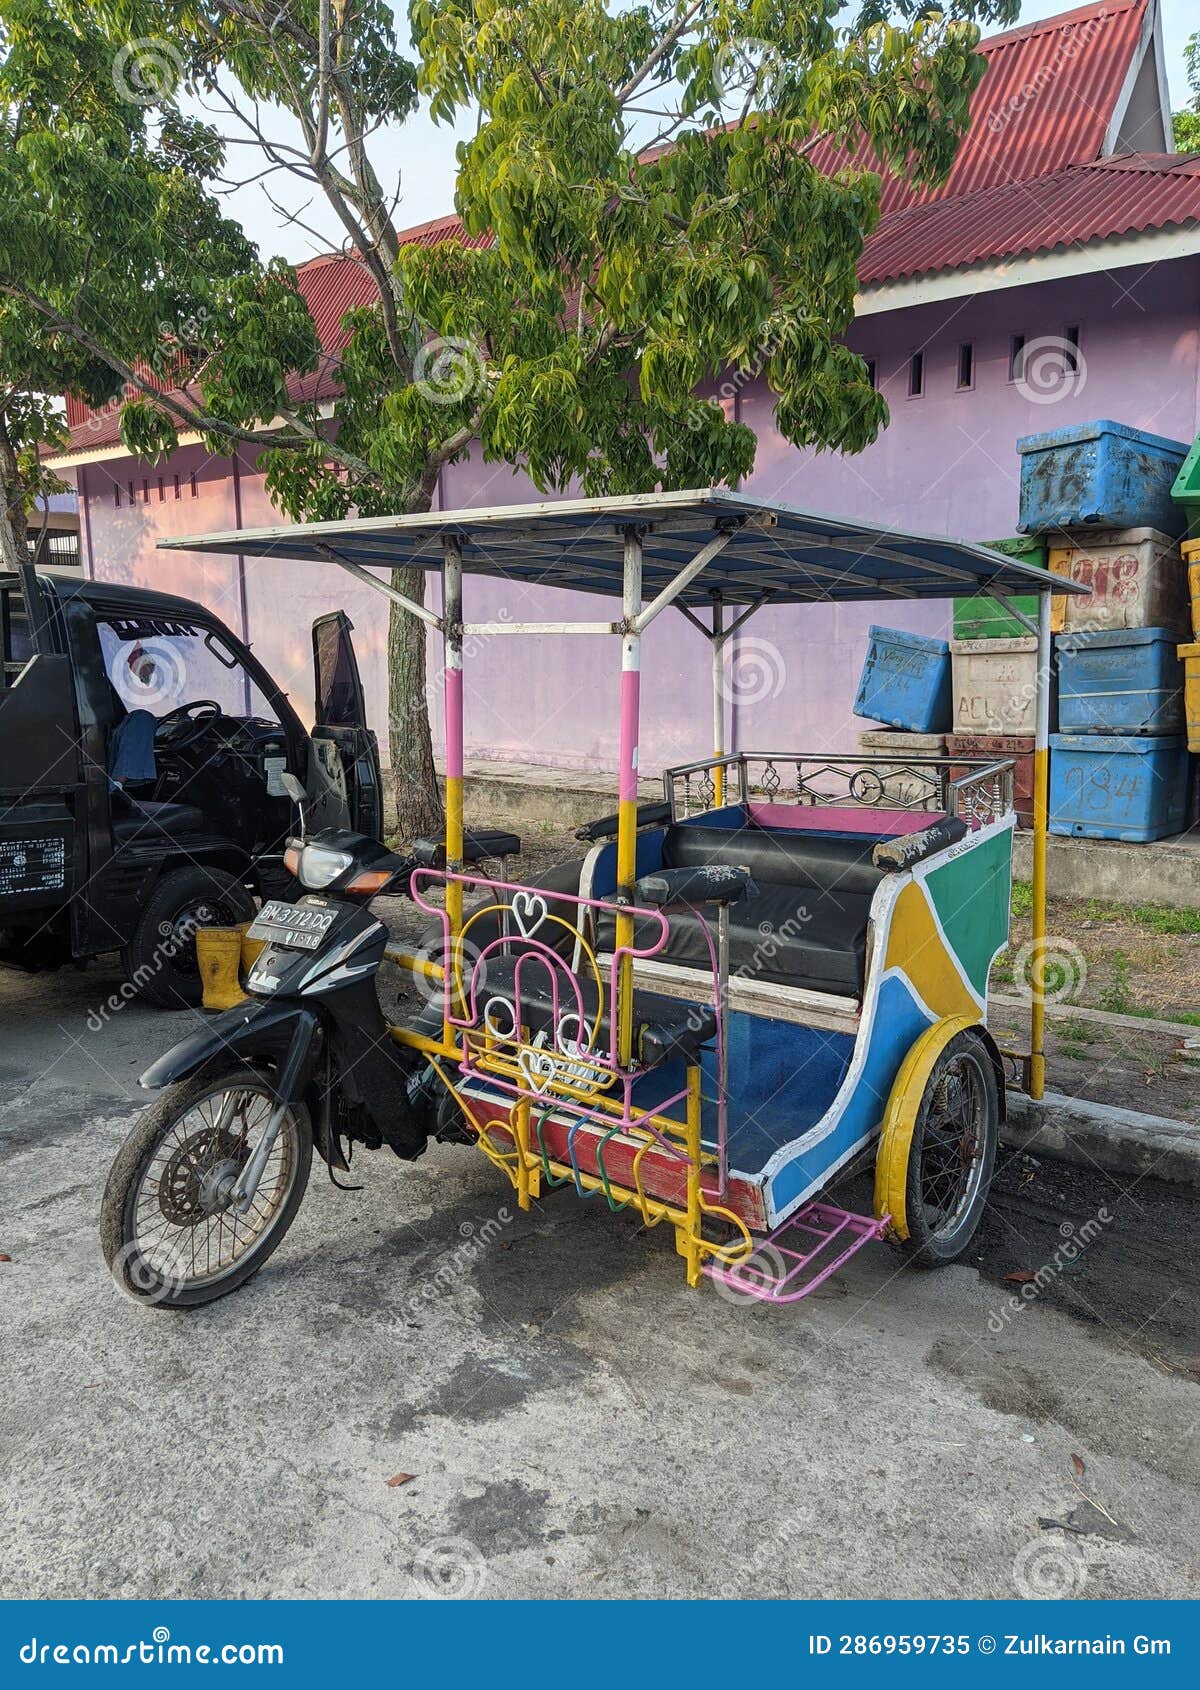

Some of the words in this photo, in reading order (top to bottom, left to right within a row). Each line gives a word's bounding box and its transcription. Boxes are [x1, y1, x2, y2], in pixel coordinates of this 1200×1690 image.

[260, 905, 281, 920] BM
[279, 908, 313, 927] 3712
[310, 913, 333, 931] DQ
